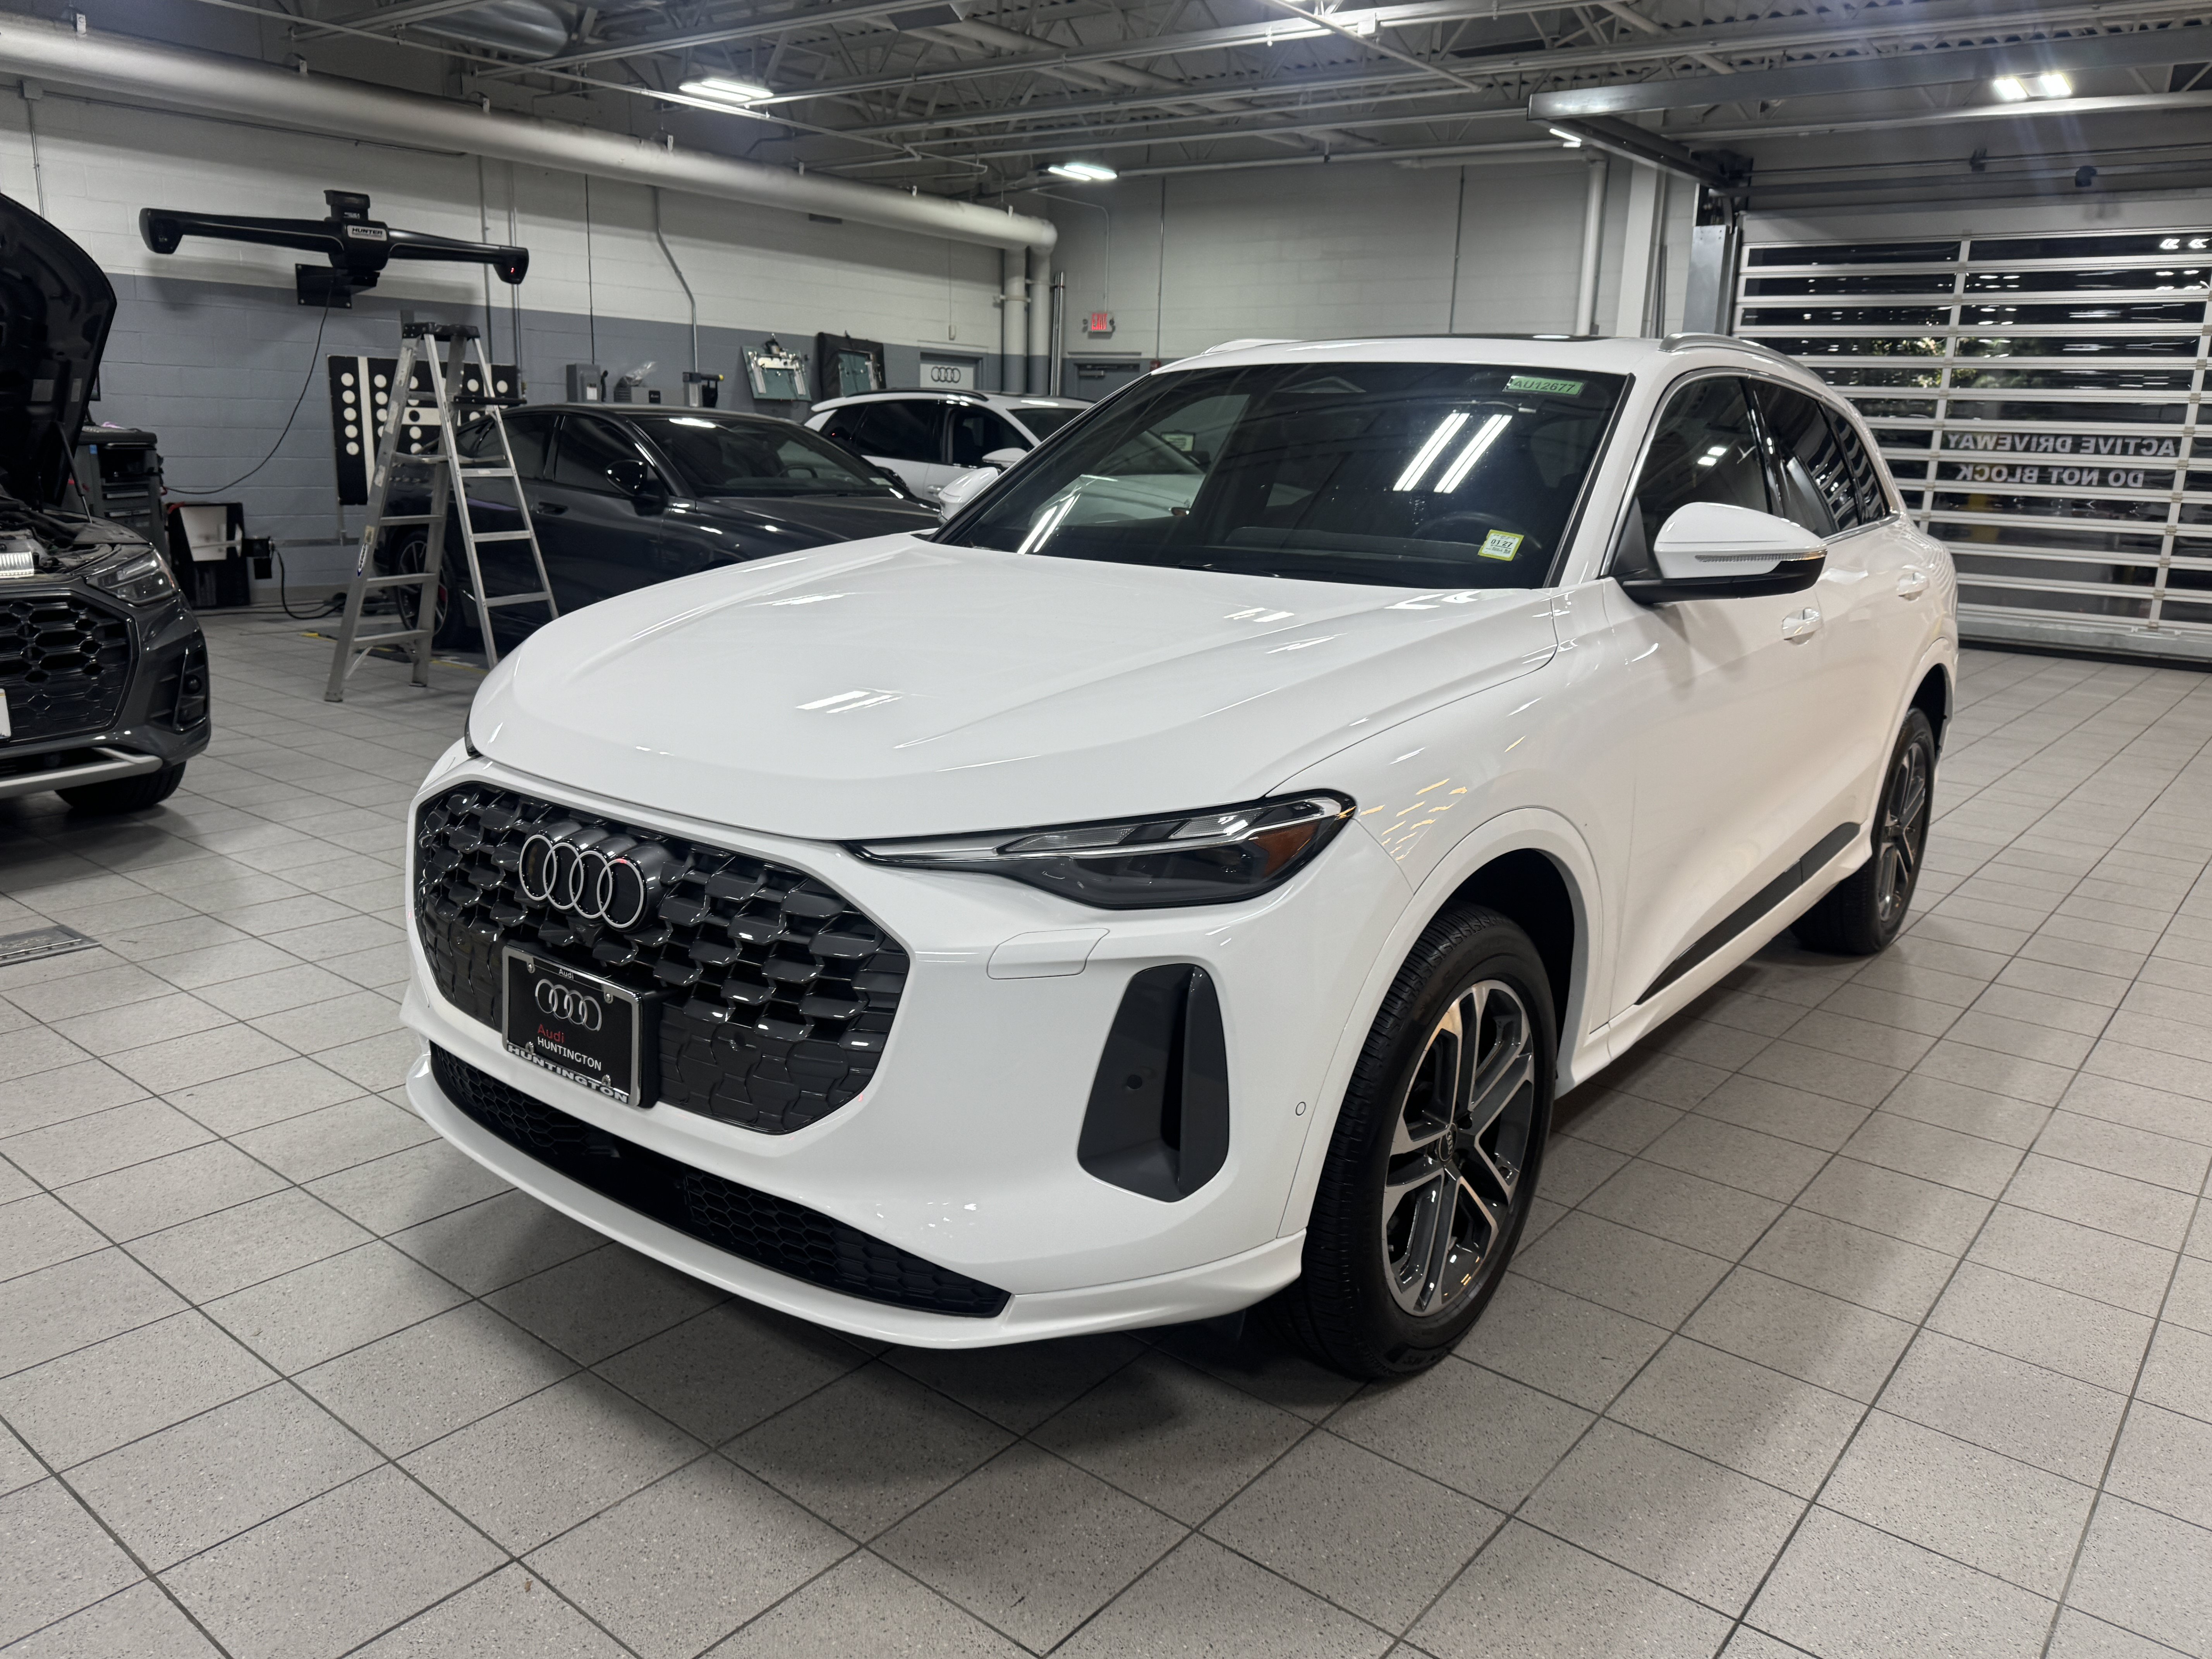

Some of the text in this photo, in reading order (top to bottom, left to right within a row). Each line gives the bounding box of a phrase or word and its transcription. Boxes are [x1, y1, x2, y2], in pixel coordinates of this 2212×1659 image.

[1514, 380, 1575, 392] AU12677
[559, 969, 574, 979] Audi
[537, 1024, 565, 1043] Audi
[538, 1036, 601, 1071] HUNTINGTON
[508, 1045, 627, 1103] HUNTINGTON
